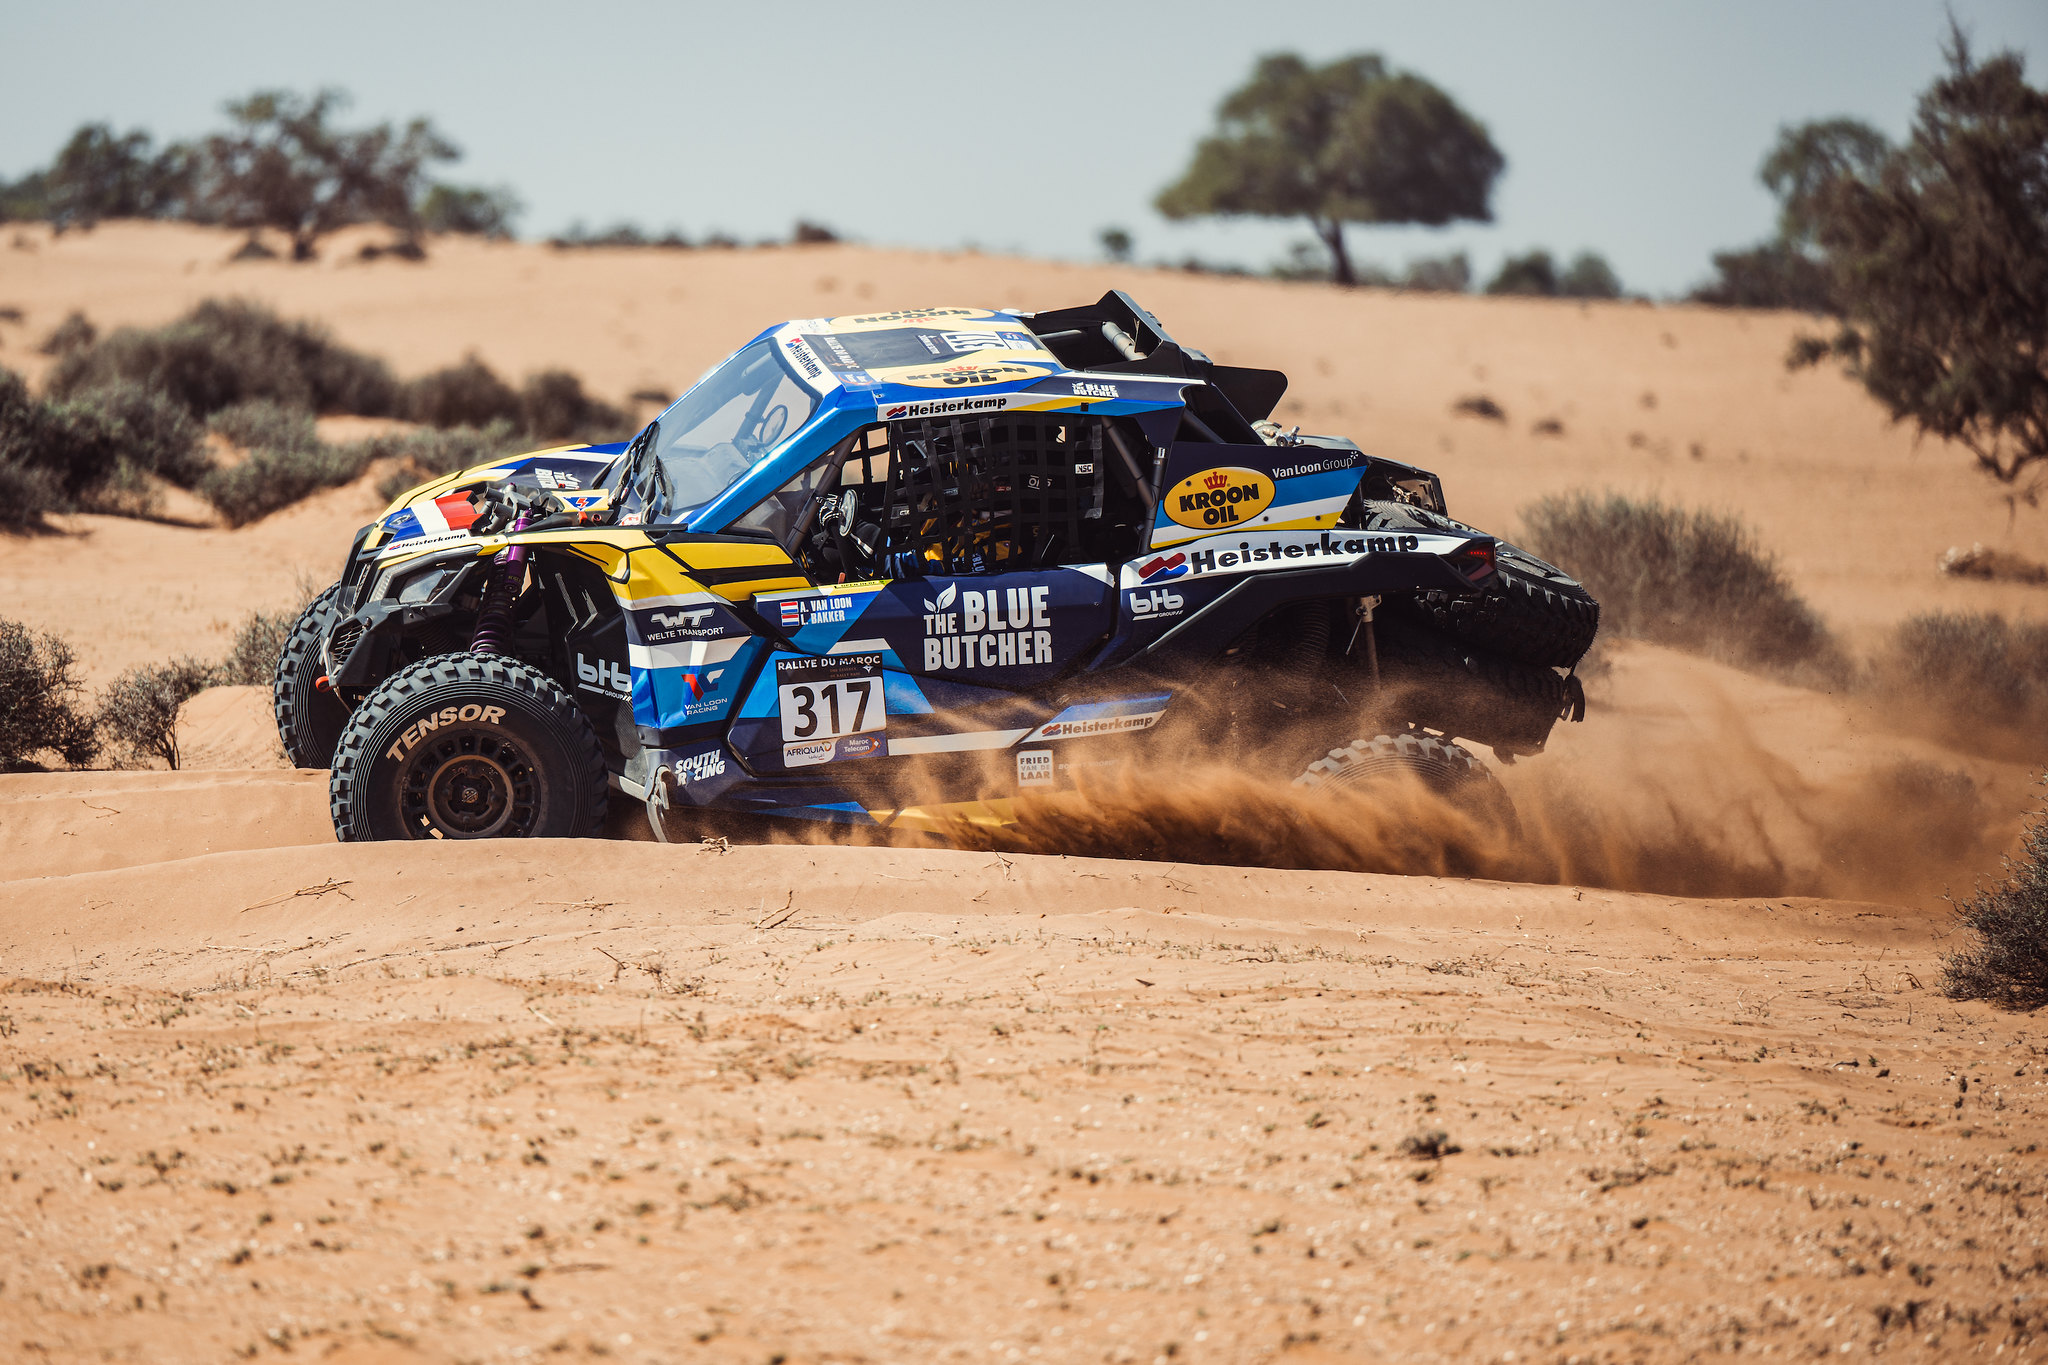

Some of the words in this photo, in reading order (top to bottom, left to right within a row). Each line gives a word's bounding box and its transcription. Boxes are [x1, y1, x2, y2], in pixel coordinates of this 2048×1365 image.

[854, 309, 972, 323] KROON
[790, 341, 822, 380] Heisterkamp
[907, 366, 1027, 380] KROON
[943, 376, 998, 385] OIL
[908, 396, 1007, 417] Heisterkamp
[1272, 467, 1293, 479] Van
[1294, 462, 1321, 476] Loon
[1322, 457, 1353, 473] Group
[1178, 483, 1260, 512] KROON
[1203, 505, 1239, 525] OIL
[402, 533, 467, 548] Heisterkamp
[1190, 534, 1419, 575] Heisterkamp
[800, 601, 808, 612] A.
[810, 599, 828, 611] VAN
[830, 597, 852, 610] LOON
[924, 613, 957, 635] THE
[963, 586, 1051, 632] BLUE
[801, 614, 809, 625] L.
[810, 610, 845, 624] BAKKER
[647, 629, 676, 641] WELTE
[677, 627, 724, 638] TRANSPORT
[924, 631, 1052, 671] BUTCHER
[778, 659, 818, 671] RALLYE
[821, 658, 836, 667] DU
[839, 655, 881, 666] MAROC
[686, 704, 718, 716] RACING
[704, 698, 728, 707] LOON
[792, 681, 871, 738] 317
[385, 703, 506, 763] TENSOR
[1062, 716, 1153, 735] Heisterkamp
[786, 746, 825, 757] AFRIQUIA
[675, 749, 721, 774] SOUTH
[1021, 771, 1051, 780] LAAR
